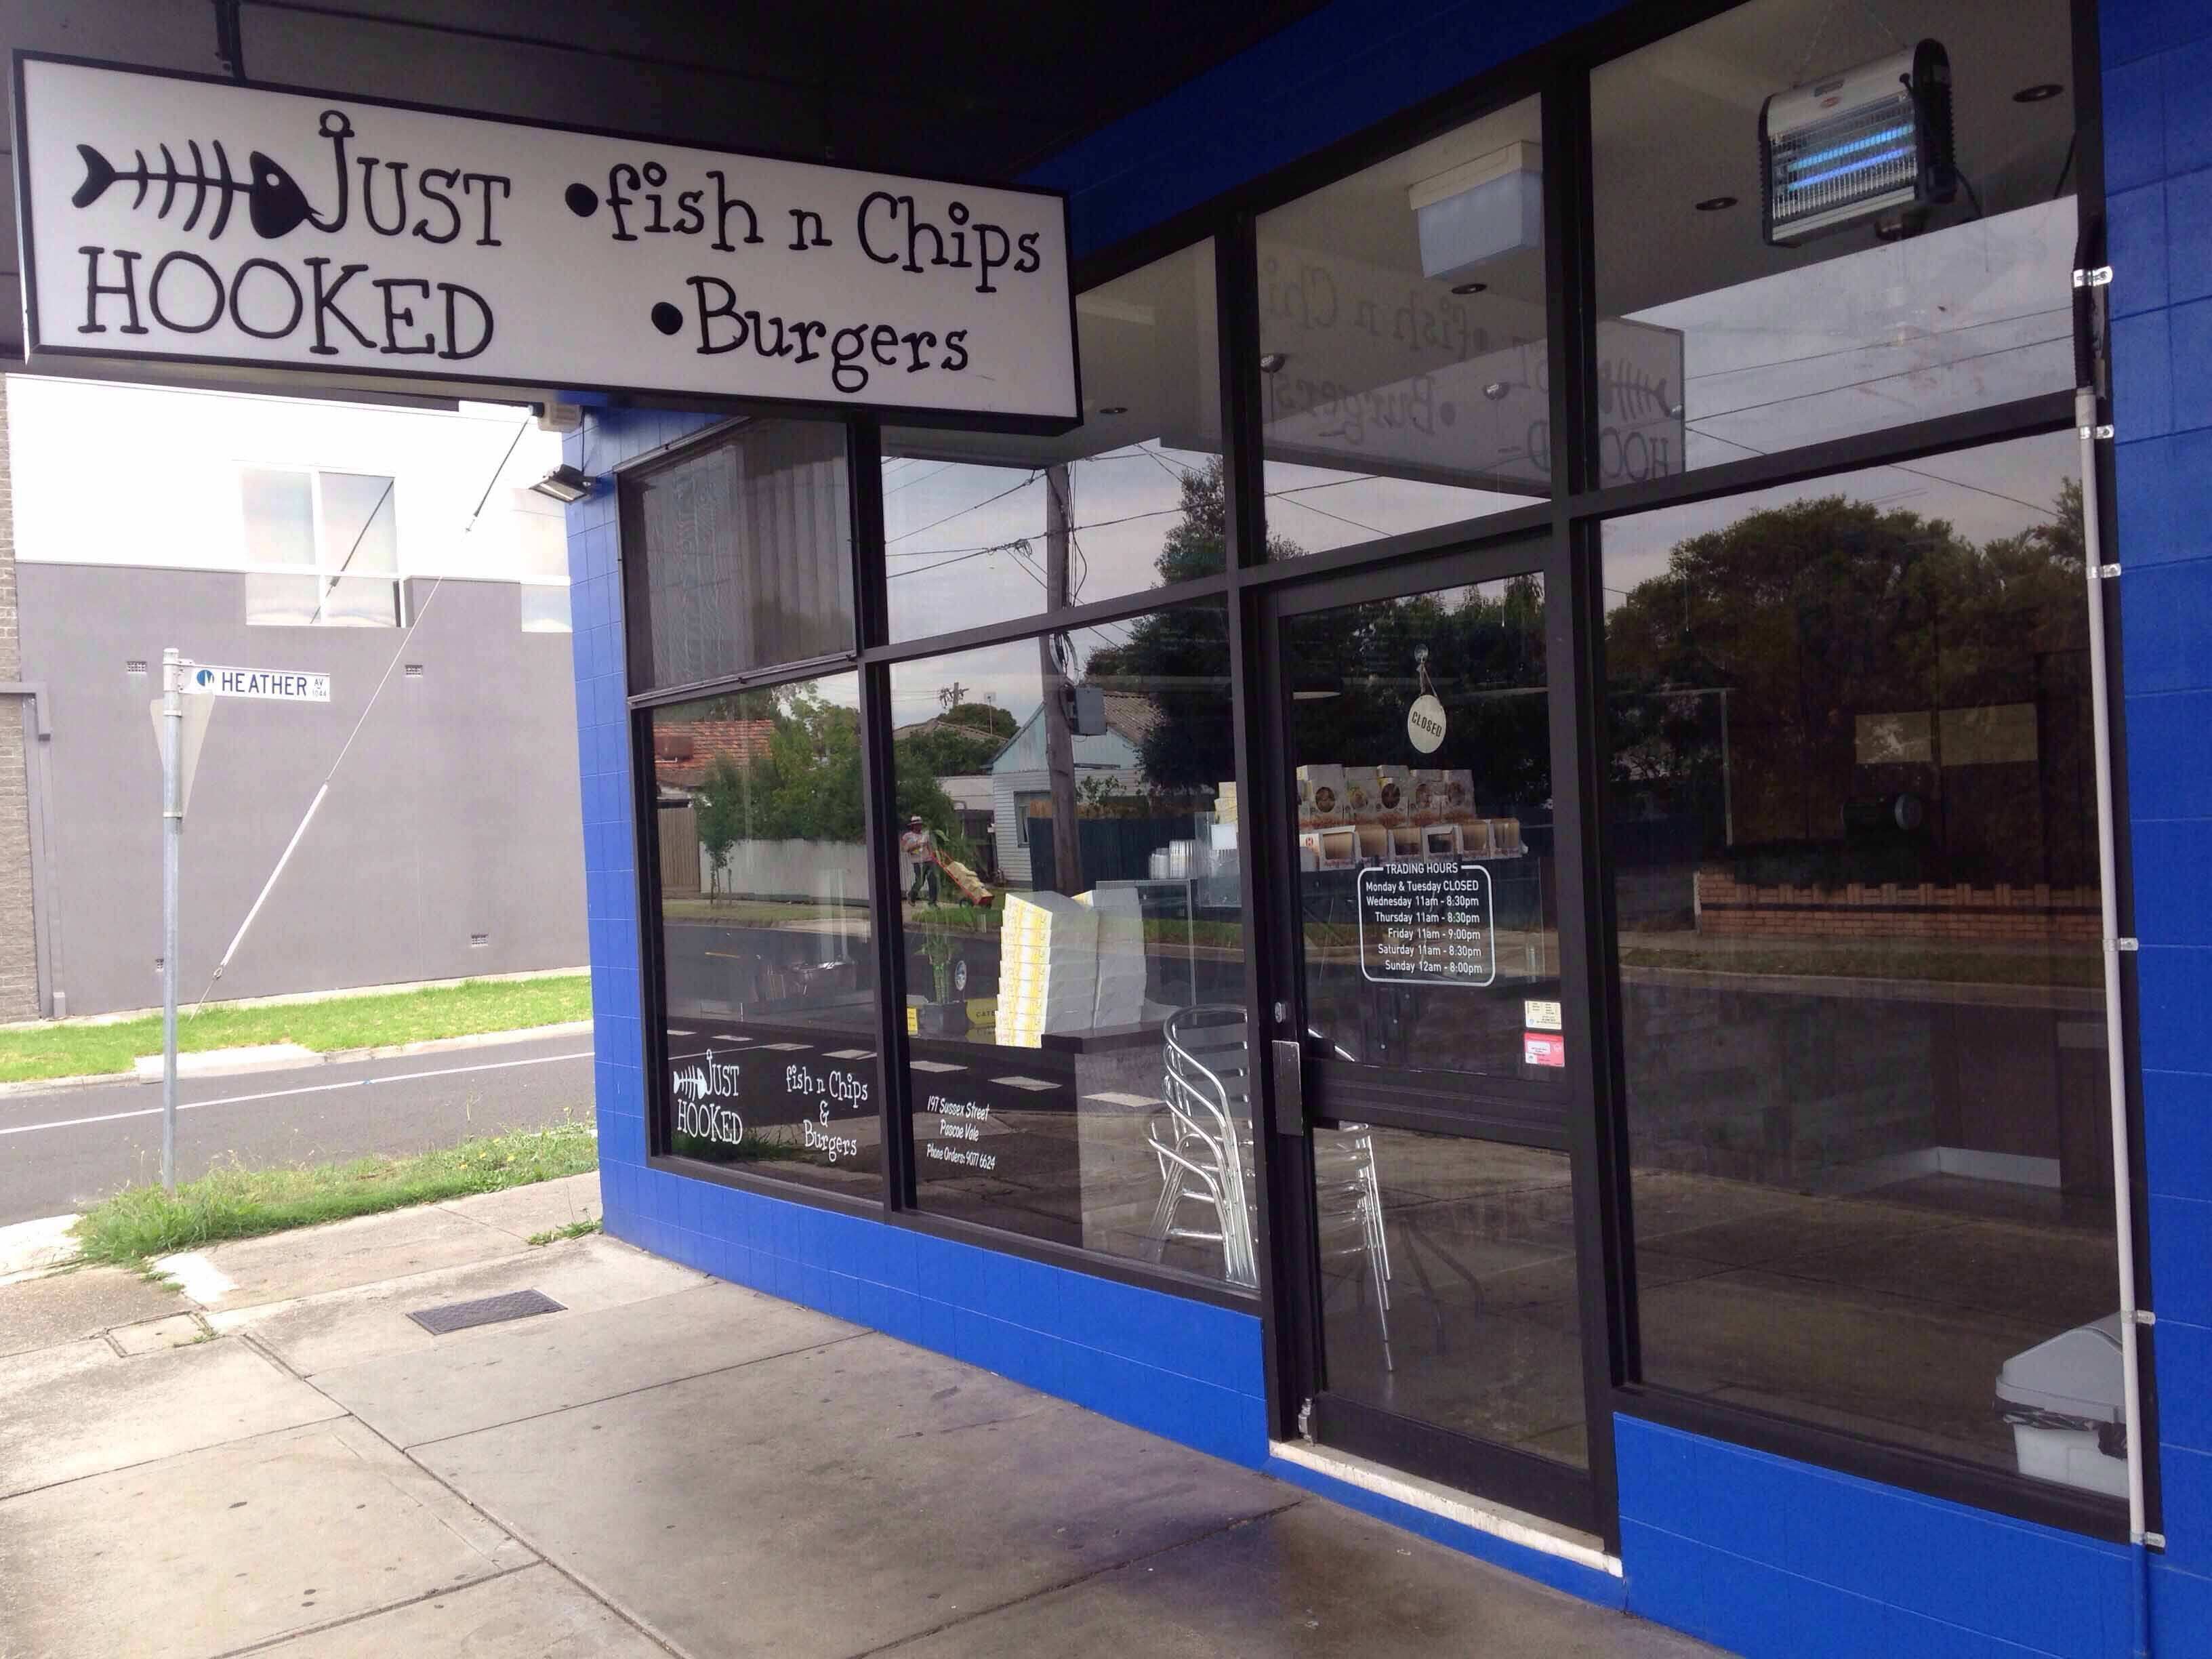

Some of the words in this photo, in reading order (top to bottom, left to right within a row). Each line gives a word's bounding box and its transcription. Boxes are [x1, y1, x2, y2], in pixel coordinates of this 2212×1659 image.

[307, 110, 511, 247] JUST
[607, 161, 764, 251] fish
[788, 207, 833, 251] n
[857, 190, 1041, 293] Chips
[77, 245, 495, 360] HOOKED
[687, 276, 969, 393] Burgers
[222, 672, 307, 696] HEATHER
[314, 678, 324, 687] AV
[1411, 711, 1442, 738] CLOSED
[1386, 863, 1424, 874] TRADING
[1427, 862, 1458, 874] HOURS
[1366, 881, 1397, 893] Monday
[1399, 881, 1405, 892] &
[1407, 880, 1441, 893] Tuesday
[1443, 880, 1479, 891] CLOSED
[1366, 895, 1412, 909] Wednesday
[1415, 895, 1439, 906] 11am
[1446, 895, 1479, 909] 8:30pm
[1375, 911, 1413, 924] Thursday
[1416, 912, 1439, 922] 11am
[1447, 912, 1480, 924] 8:30pm
[1388, 928, 1414, 941] Friday
[1417, 928, 1440, 939] 11am
[1448, 928, 1481, 942] 9:00pm
[1378, 943, 1414, 957] Saturday
[1418, 944, 1441, 955] 11am
[1449, 945, 1481, 958] 8:30pm
[1385, 960, 1415, 973] Sunday
[1418, 960, 1441, 972] 12am
[1450, 962, 1482, 975] 8:00pm
[705, 1048, 739, 1097] JUST
[786, 1065, 813, 1095] fish
[817, 1078, 825, 1093] n
[829, 1070, 868, 1108] Chips
[677, 1098, 743, 1145] HOOKED
[819, 1100, 830, 1127] &
[927, 1095, 939, 1111] 197
[939, 1097, 965, 1117] Sussex
[966, 1101, 990, 1122] Street
[804, 1119, 857, 1162] Burgers
[939, 1118, 964, 1139] Pascoe
[965, 1123, 979, 1142] Vale
[926, 1143, 943, 1160] Phone
[943, 1146, 966, 1164] Orders:
[979, 1153, 996, 1170] 6624
